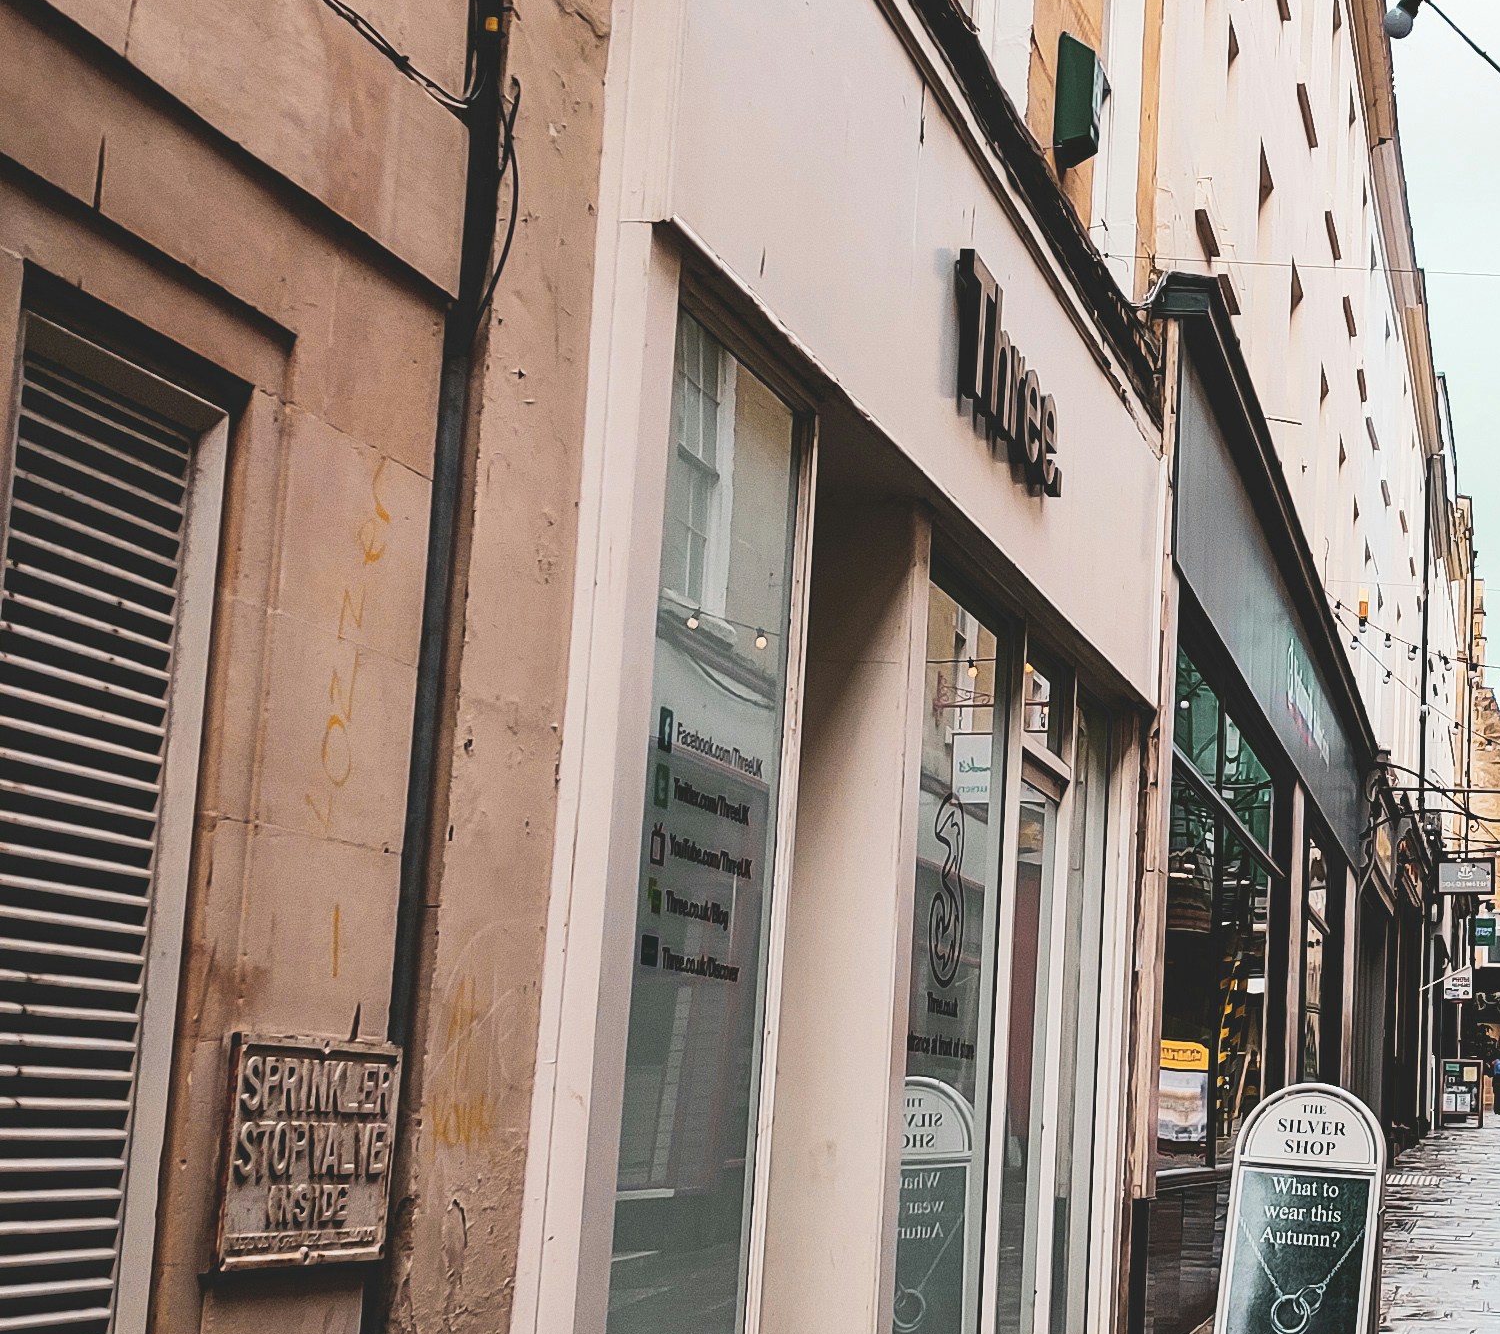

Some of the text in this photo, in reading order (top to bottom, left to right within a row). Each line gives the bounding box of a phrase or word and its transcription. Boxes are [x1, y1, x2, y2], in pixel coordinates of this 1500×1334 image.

[676, 721, 764, 779] Facebook.com/ThreeUK
[673, 776, 751, 826] Twitter.com/ThreeUK
[669, 832, 753, 880] YouTube.com/ThreeUK
[665, 889, 729, 931] Three.co.uk/Blog
[661, 946, 740, 983] Three.co.uk/Discover
[240, 1055, 394, 1112] SPRINKLER
[1276, 1117, 1347, 1137] SILVER
[1301, 1103, 1327, 1115] THE
[1283, 1138, 1337, 1157] SHOP
[266, 1183, 350, 1227] INSIDE
[1271, 1176, 1340, 1198] What to
[1263, 1201, 1342, 1223] wear this
[1258, 1226, 1342, 1249] Autumn?
